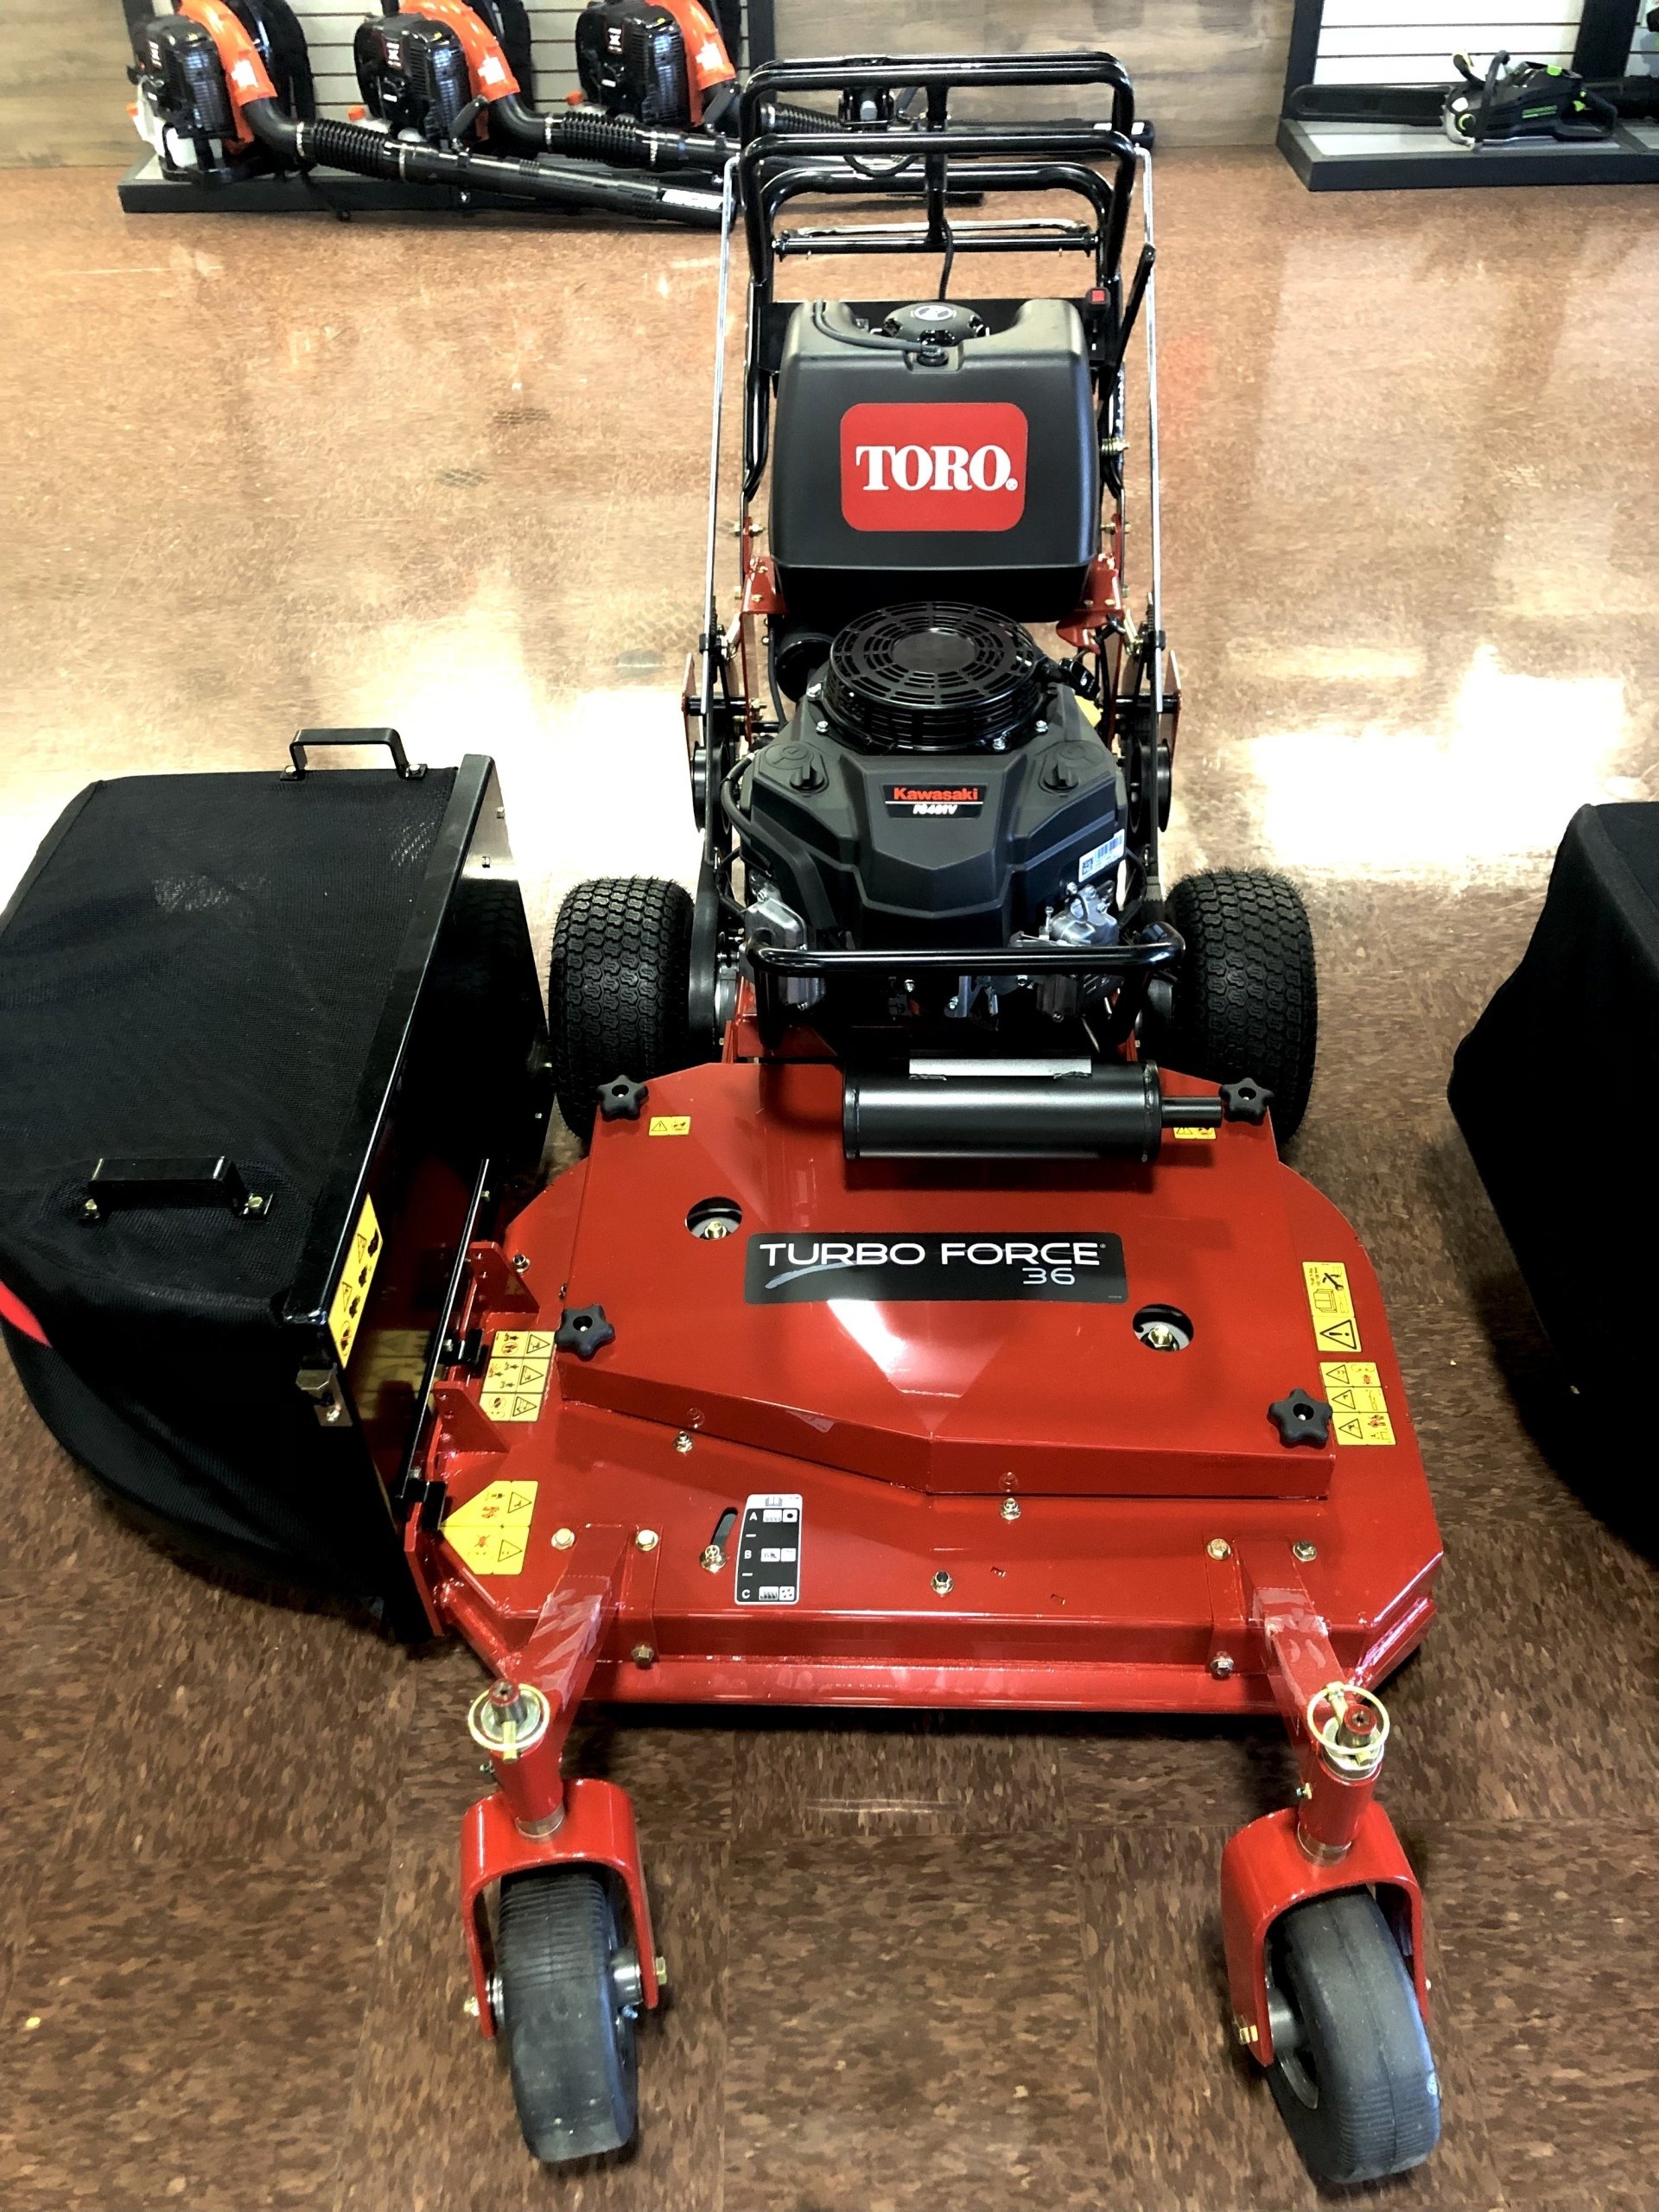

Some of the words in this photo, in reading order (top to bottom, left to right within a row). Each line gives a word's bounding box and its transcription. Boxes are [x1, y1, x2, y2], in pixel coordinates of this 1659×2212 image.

[893, 787, 978, 800] Kawasaki
[759, 1243, 925, 1267] TURBO
[1021, 1267, 1076, 1286] 36
[749, 1511, 758, 1521] A
[744, 1549, 752, 1560] B
[741, 1589, 751, 1599] C
